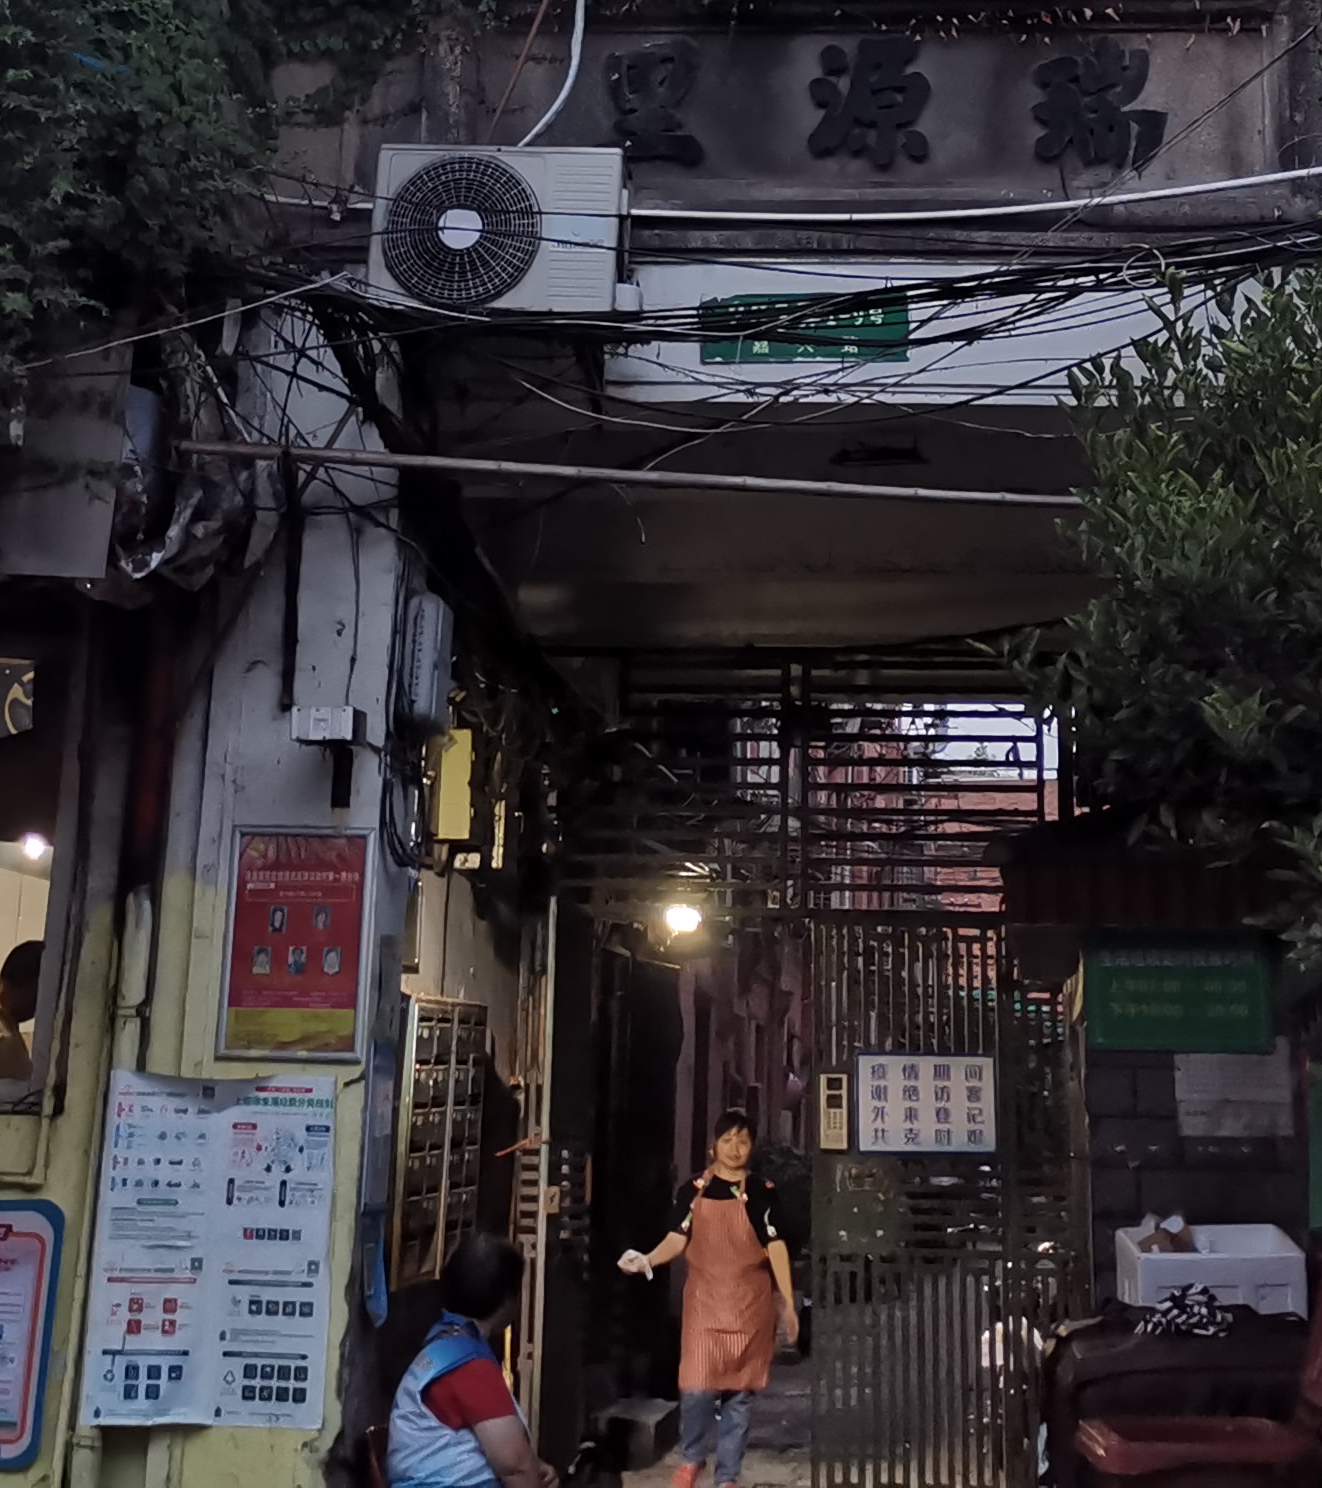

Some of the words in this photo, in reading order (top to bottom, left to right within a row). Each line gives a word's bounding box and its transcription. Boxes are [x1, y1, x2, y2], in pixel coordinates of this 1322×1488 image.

[870, 1063, 984, 1082] 疫情期间
[871, 1084, 983, 1103] 谢绝访客
[871, 1105, 985, 1125] 外来登记
[871, 1127, 985, 1146] 共克时艰
